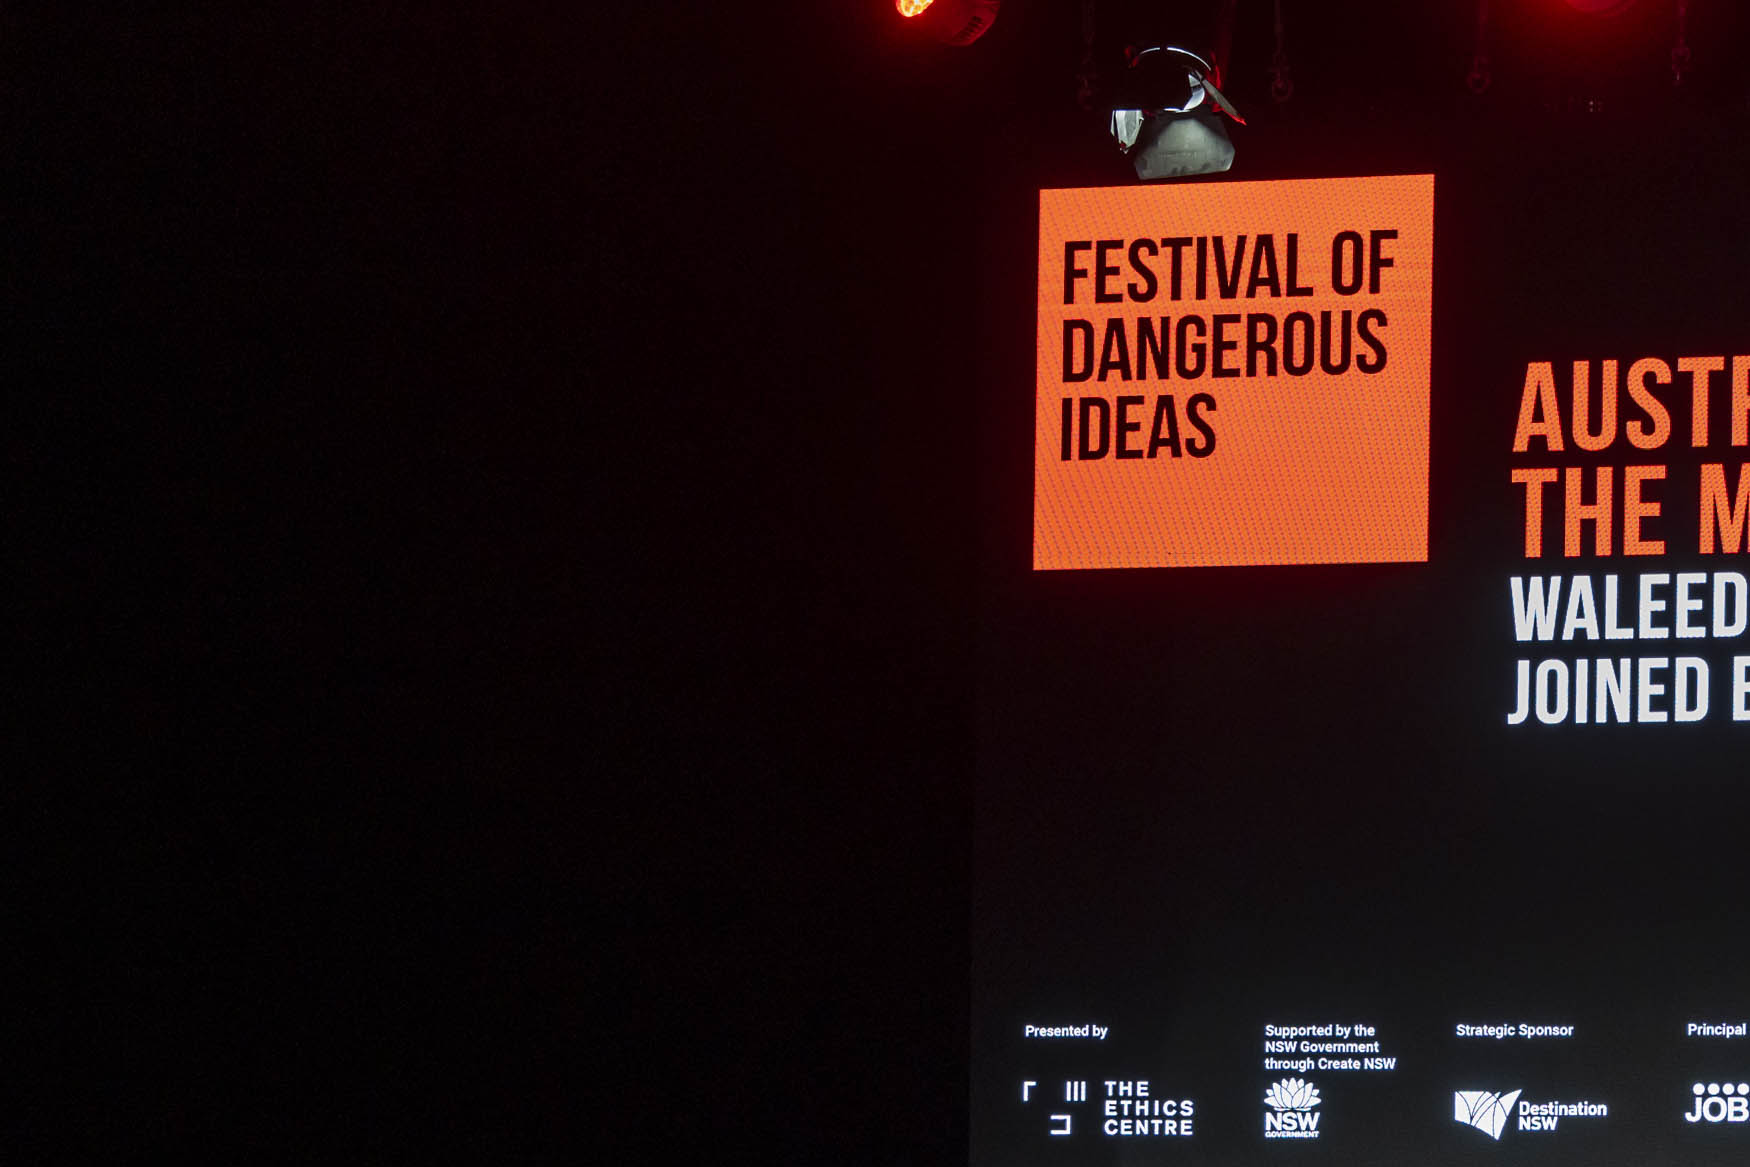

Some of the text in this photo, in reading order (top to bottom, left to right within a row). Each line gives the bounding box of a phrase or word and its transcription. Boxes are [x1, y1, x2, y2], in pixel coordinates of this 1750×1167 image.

[1064, 230, 1398, 304] FESTIVAL OF
[1063, 309, 1387, 383] DANGEROUS
[1061, 393, 1216, 461] IDEAS
[1512, 465, 1667, 558] THE
[1510, 572, 1747, 641] WALEED
[1508, 657, 1709, 724] JOINED
[1025, 1025, 1108, 1040] Presented by
[1265, 1024, 1375, 1040] Supported by the
[1456, 1024, 1574, 1039] Strategic Sponsor
[1688, 1023, 1746, 1038] Principal
[1265, 1041, 1379, 1053] NSW Government
[1264, 1057, 1396, 1072] through Create NSW
[1104, 1081, 1149, 1096] THE
[1104, 1100, 1193, 1116] ETHICS
[1518, 1101, 1608, 1117] Destination
[1104, 1119, 1193, 1136] CENTRE
[1265, 1112, 1320, 1131] NSW
[1518, 1116, 1558, 1131] NSW
